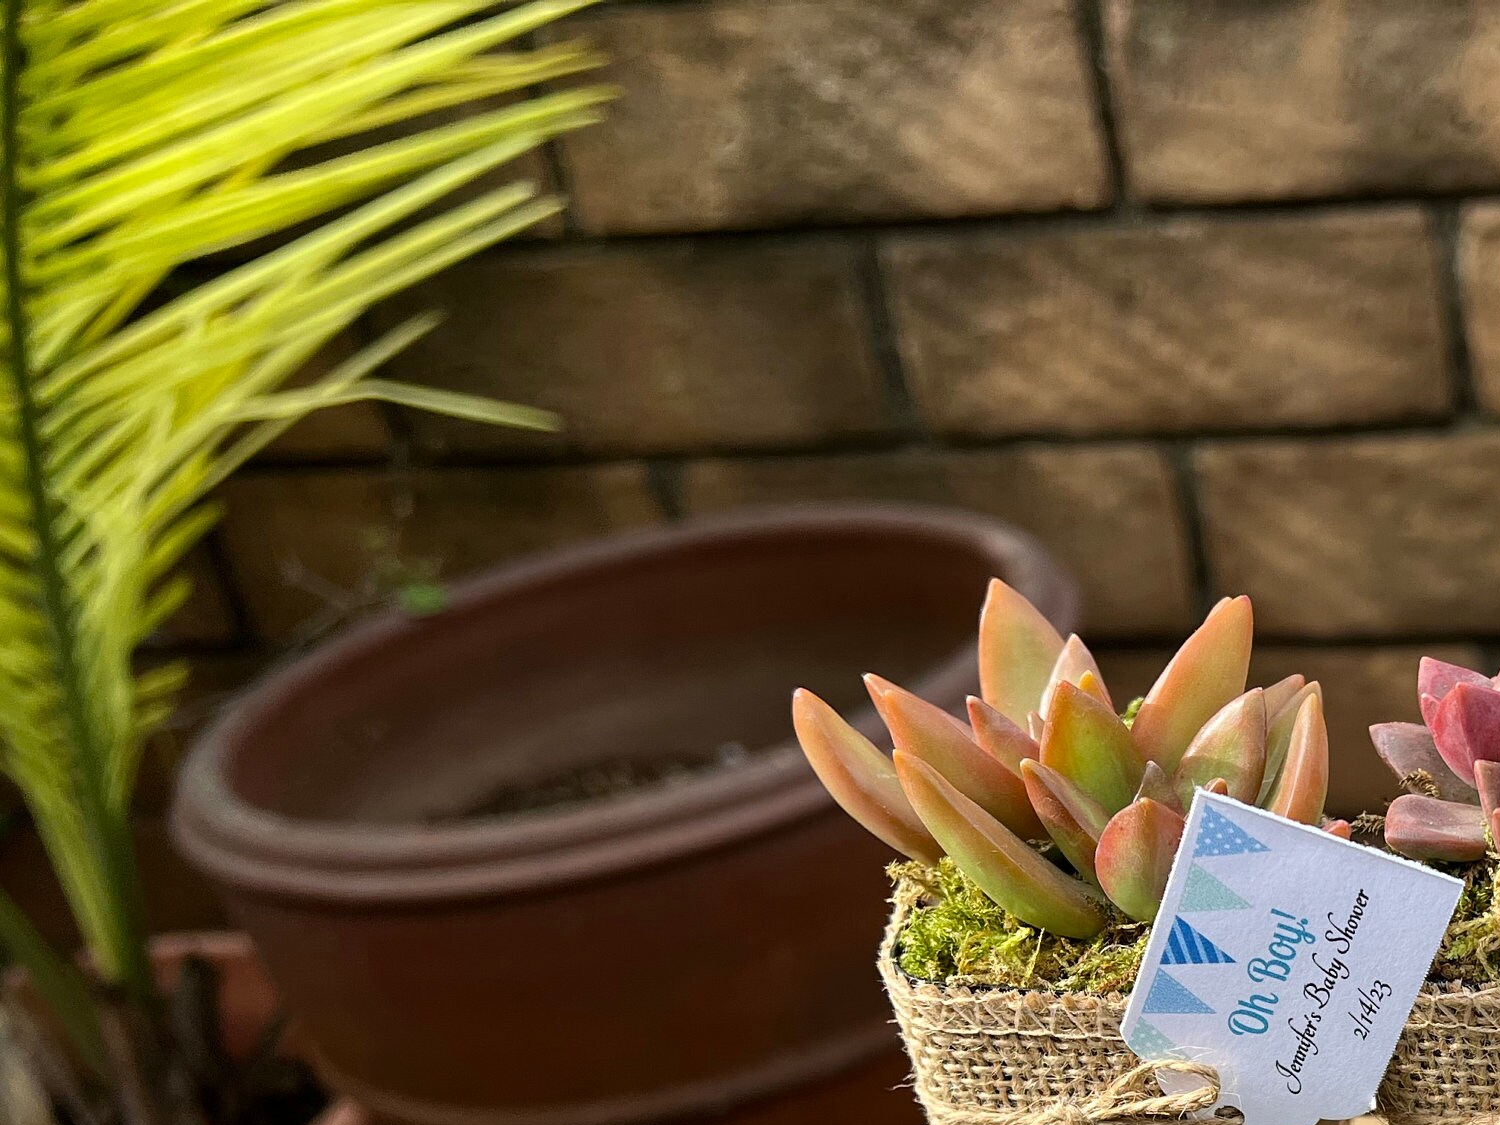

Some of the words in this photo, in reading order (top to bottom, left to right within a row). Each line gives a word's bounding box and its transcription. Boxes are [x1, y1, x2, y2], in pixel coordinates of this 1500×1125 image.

[1247, 908, 1316, 982] Boy!
[1324, 889, 1370, 954] Shower
[1303, 953, 1350, 1009] Baby
[1348, 980, 1392, 1041] 2/14/23
[1228, 994, 1279, 1035] Oh
[1275, 1011, 1322, 1095] Jennifer's
